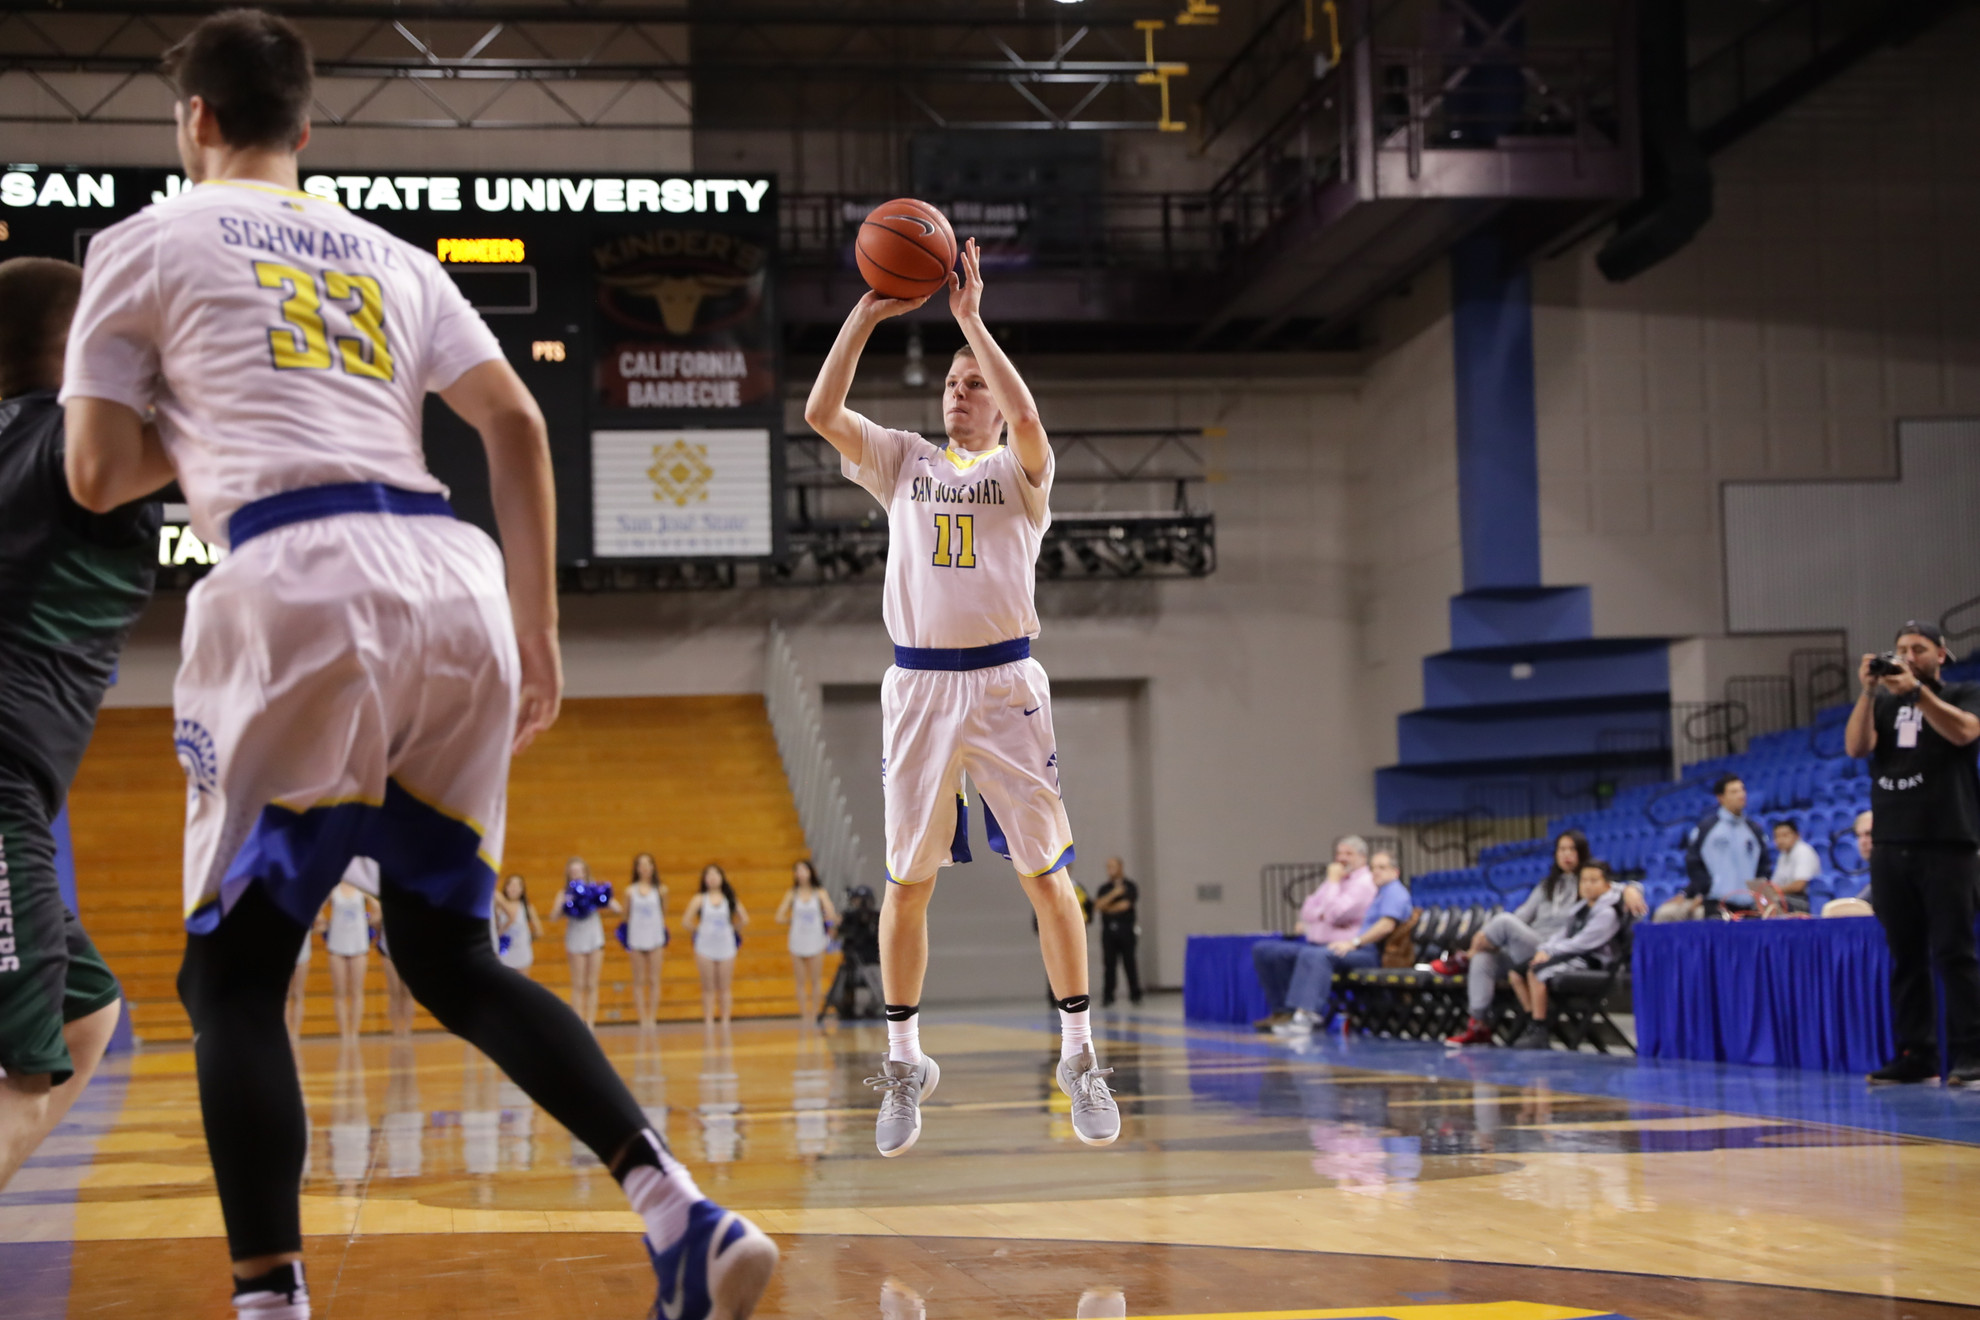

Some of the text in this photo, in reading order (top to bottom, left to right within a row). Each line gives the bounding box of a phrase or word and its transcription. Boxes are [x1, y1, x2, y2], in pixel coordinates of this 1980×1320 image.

[0, 173, 115, 208] SAN
[303, 174, 462, 211] STATE
[474, 178, 770, 213] UNIVERSITY
[252, 260, 395, 382] 33
[618, 351, 748, 378] CALIFORNIA
[627, 381, 741, 408] BARBECUE
[911, 476, 933, 503] SAN
[968, 479, 1005, 505] STATE
[932, 513, 977, 569] 11
